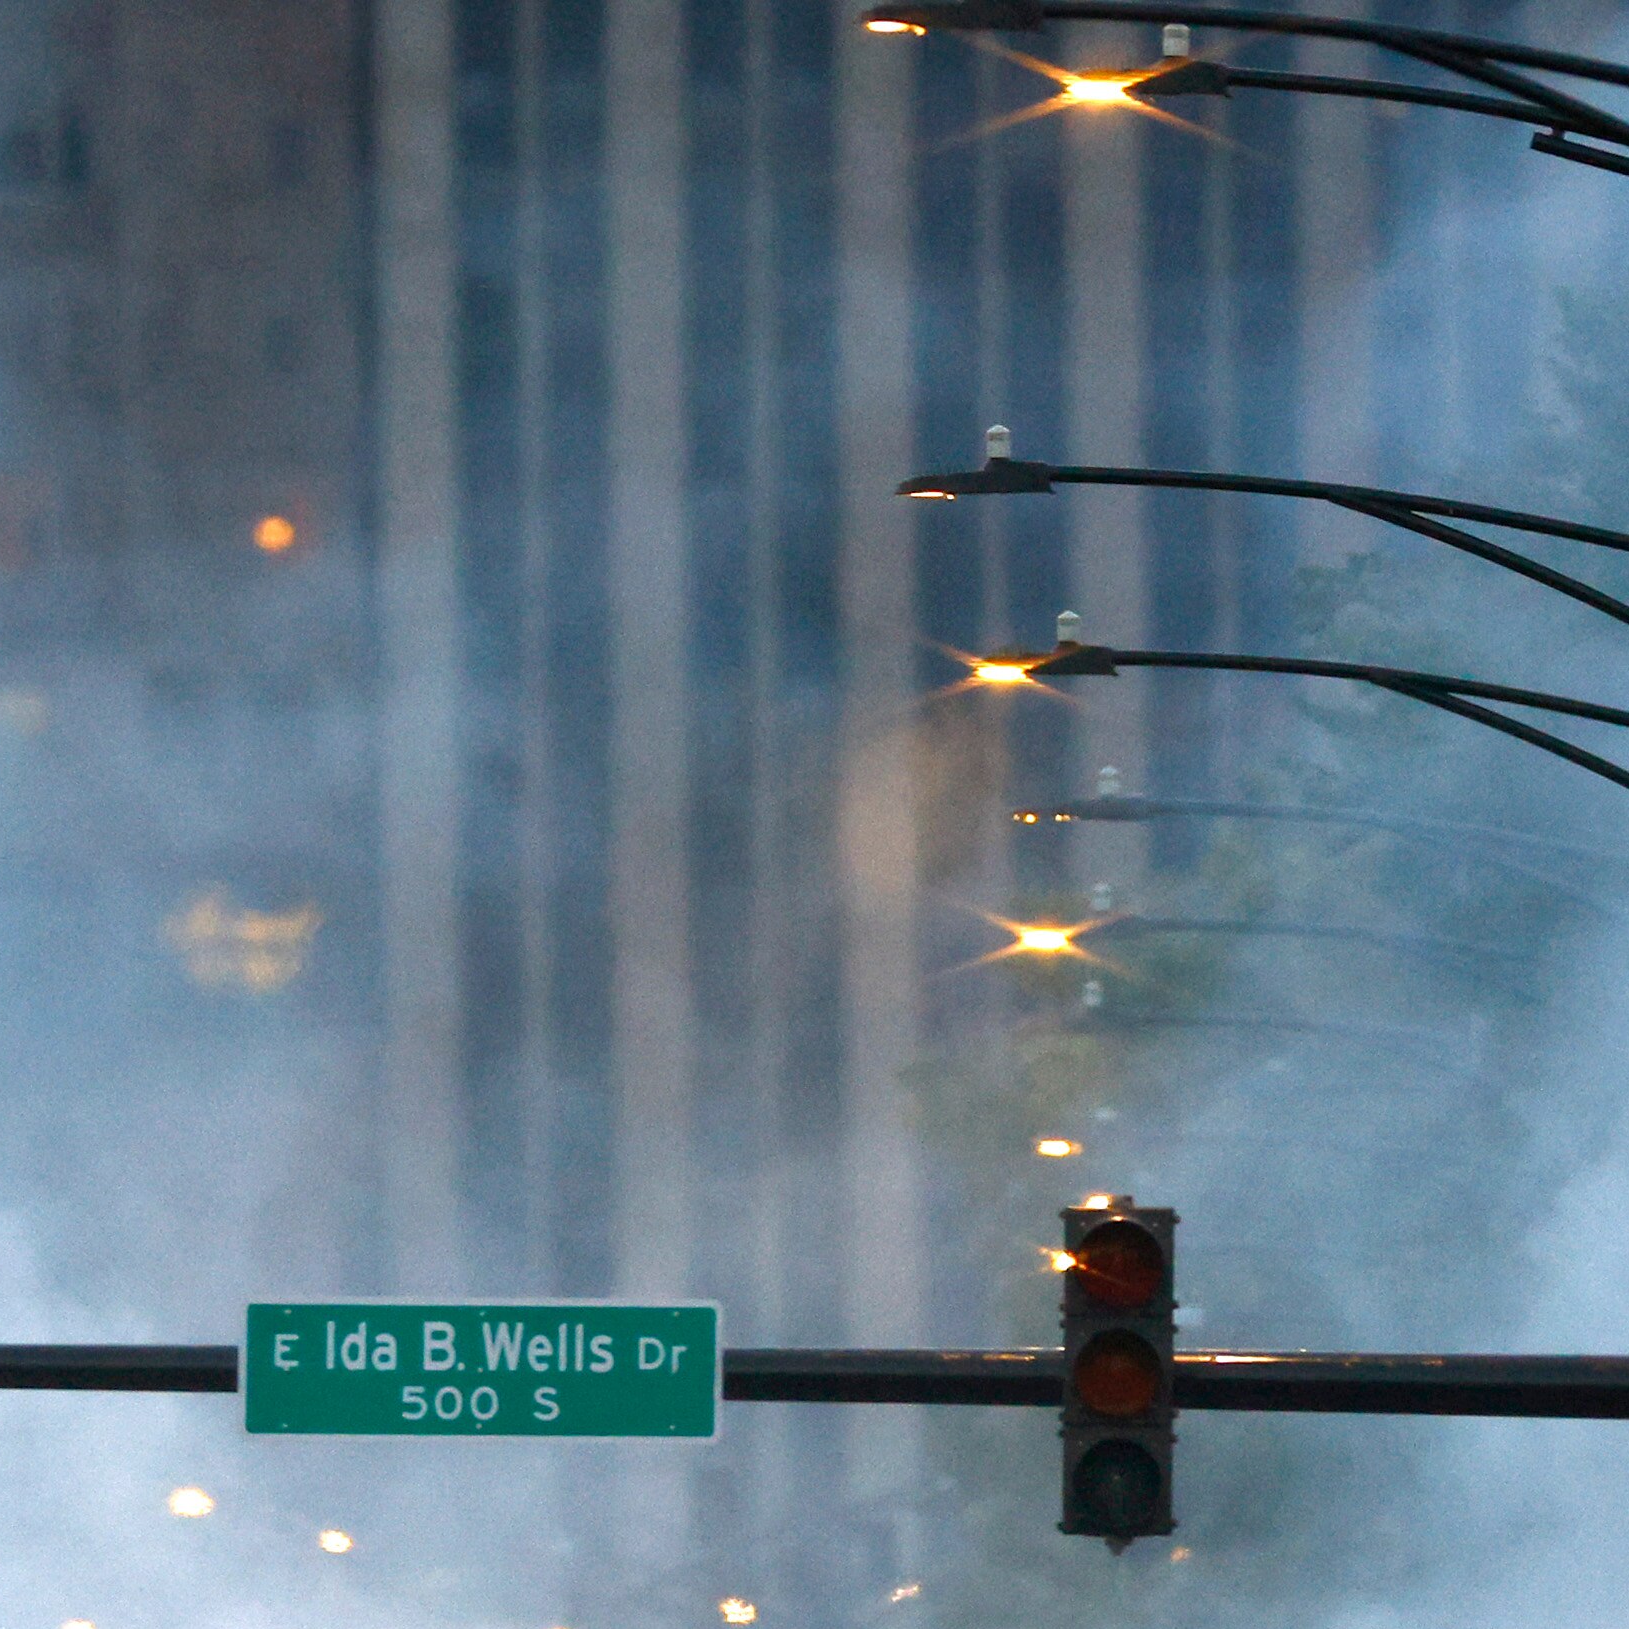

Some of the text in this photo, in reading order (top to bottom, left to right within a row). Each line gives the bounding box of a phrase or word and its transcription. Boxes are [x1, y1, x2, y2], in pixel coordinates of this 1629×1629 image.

[273, 1321, 687, 1373] E Ida B. Wells Dr
[402, 1386, 561, 1420] 500 S
